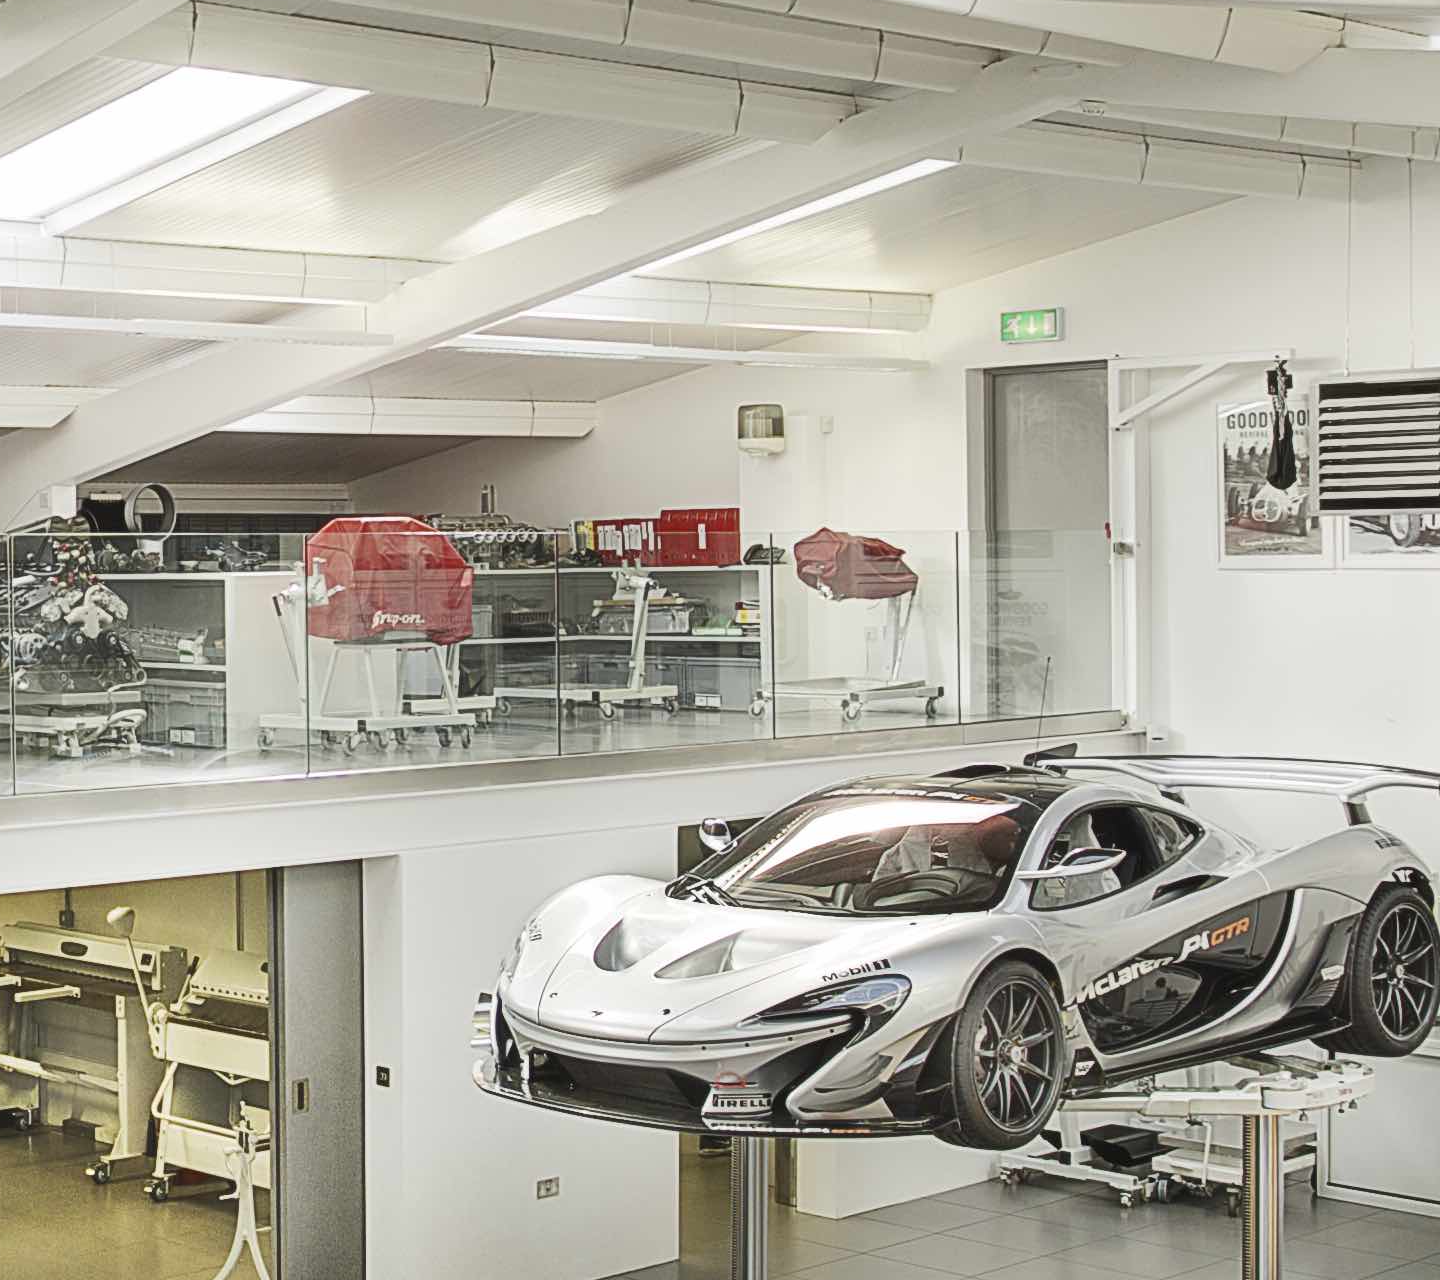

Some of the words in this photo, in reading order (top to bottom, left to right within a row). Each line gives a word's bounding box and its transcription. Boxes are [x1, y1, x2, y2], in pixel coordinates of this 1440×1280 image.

[822, 962, 871, 982] Mobil
[1063, 955, 1174, 1010] McLaren
[1211, 917, 1250, 947] GTR
